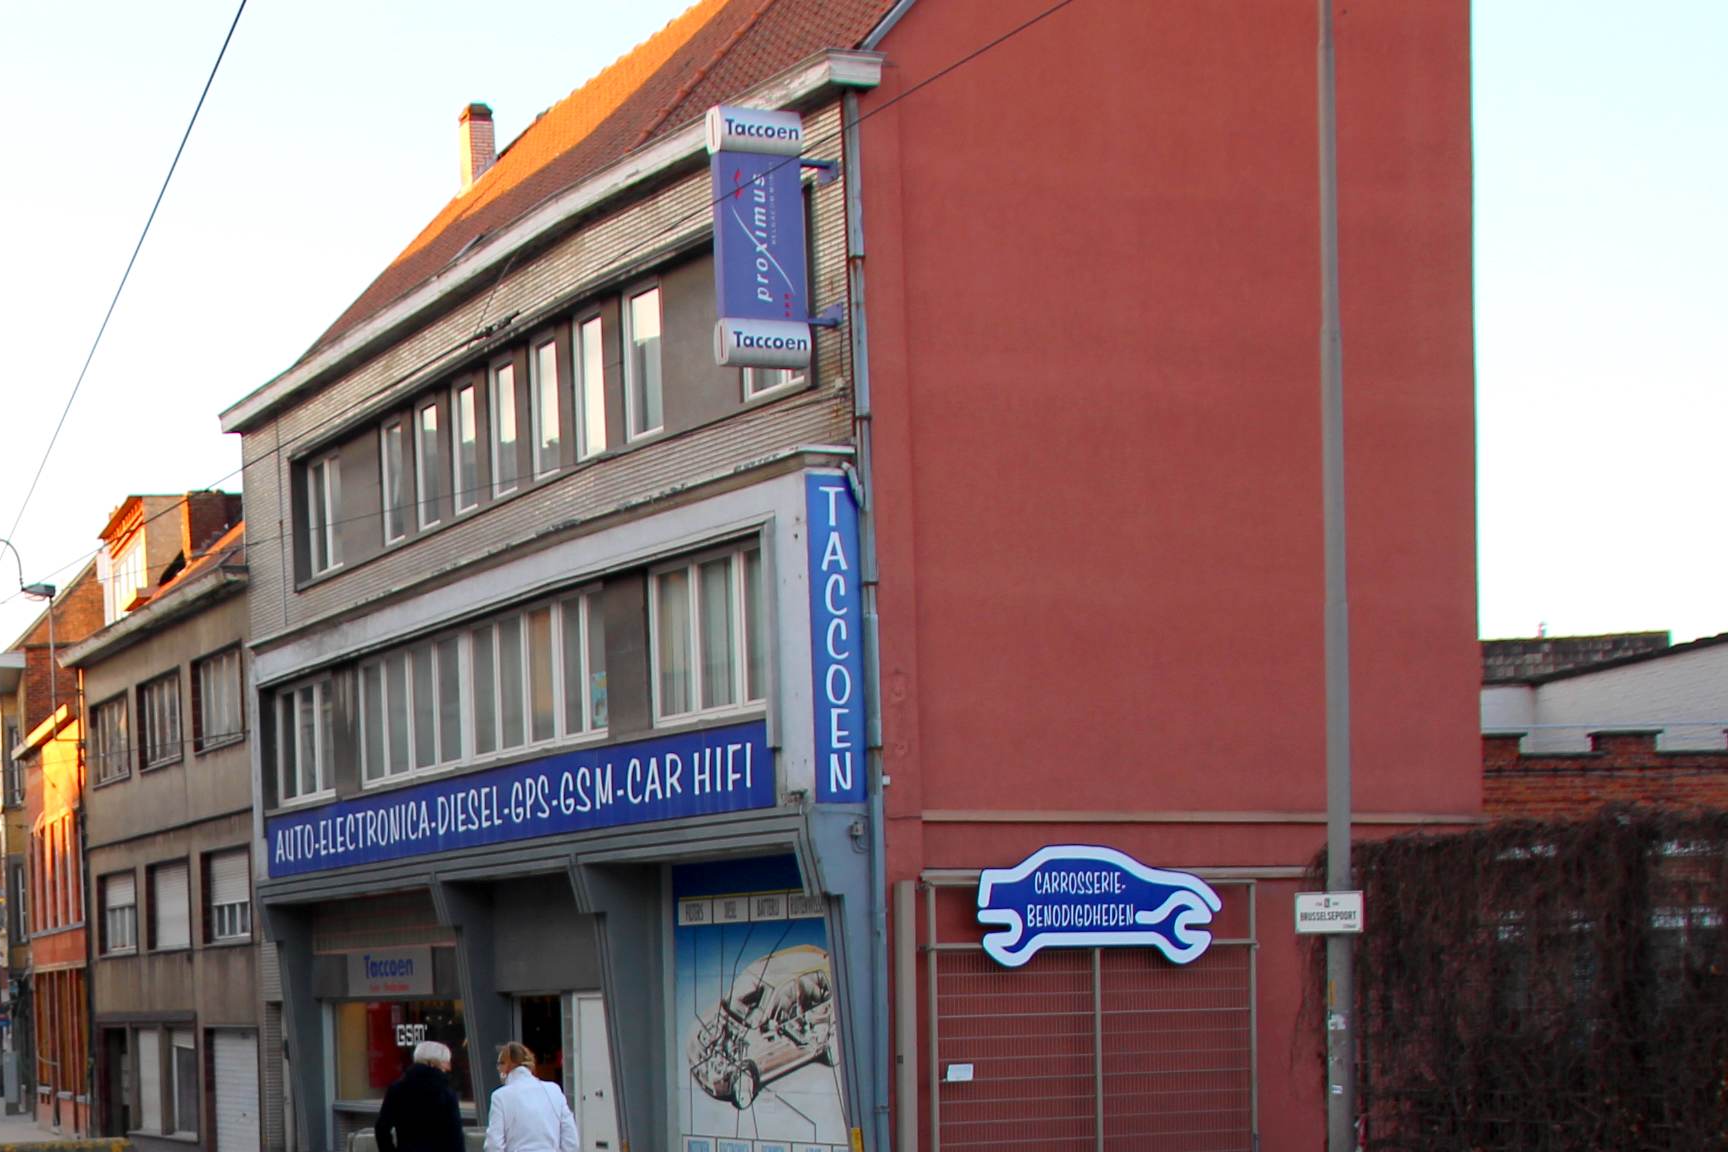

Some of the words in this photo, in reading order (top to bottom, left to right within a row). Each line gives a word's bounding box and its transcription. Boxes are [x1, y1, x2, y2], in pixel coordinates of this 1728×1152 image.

[725, 118, 800, 140] Taccoen
[753, 172, 773, 303] proximus
[733, 330, 808, 351] Taccoen
[819, 486, 852, 793] TACCOEN
[693, 742, 752, 796] HIFI
[1027, 903, 1134, 927] BENODIGDHEDEN
[1300, 911, 1356, 921] BRUSSELSEPOORT
[364, 954, 414, 979] Taccoen
